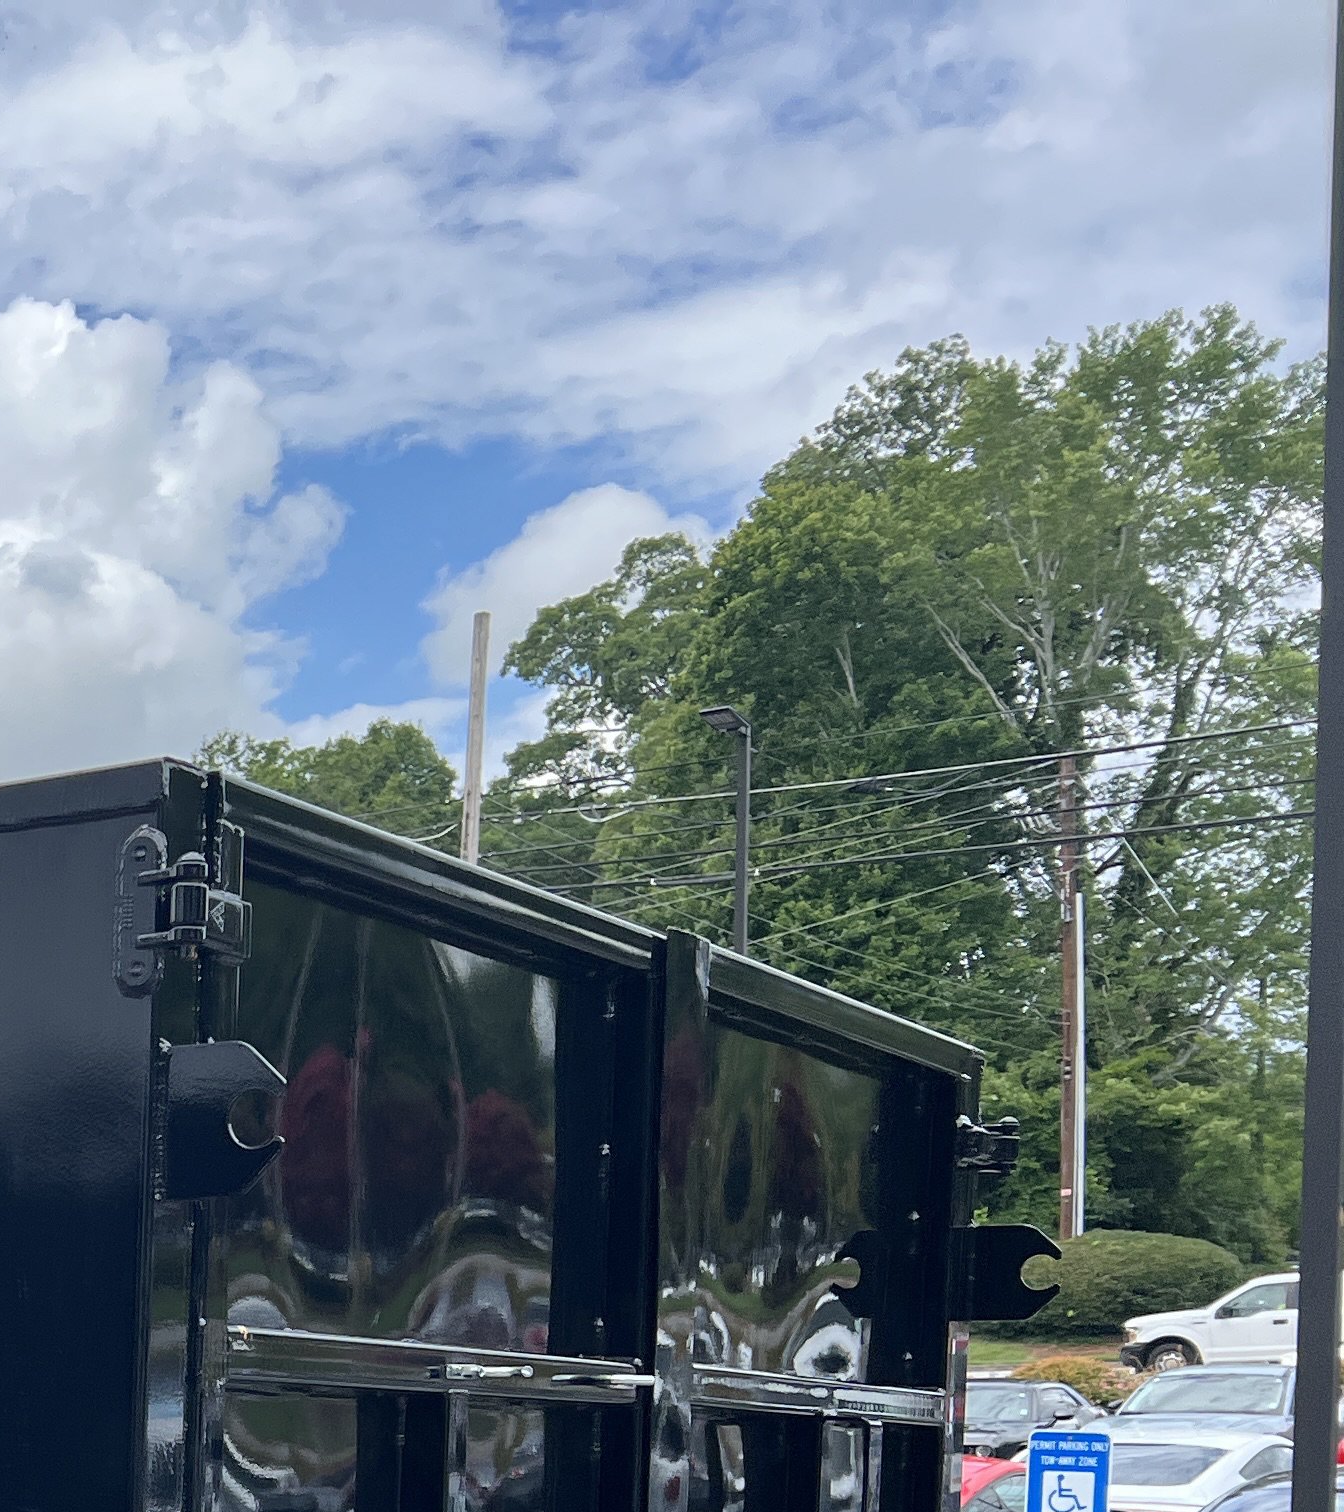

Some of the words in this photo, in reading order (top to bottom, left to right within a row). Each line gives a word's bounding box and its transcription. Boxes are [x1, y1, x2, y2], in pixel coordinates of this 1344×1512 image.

[1031, 1440, 1056, 1451] PERMIT
[1058, 1441, 1089, 1451] PARKING
[1091, 1442, 1109, 1452] ONLY
